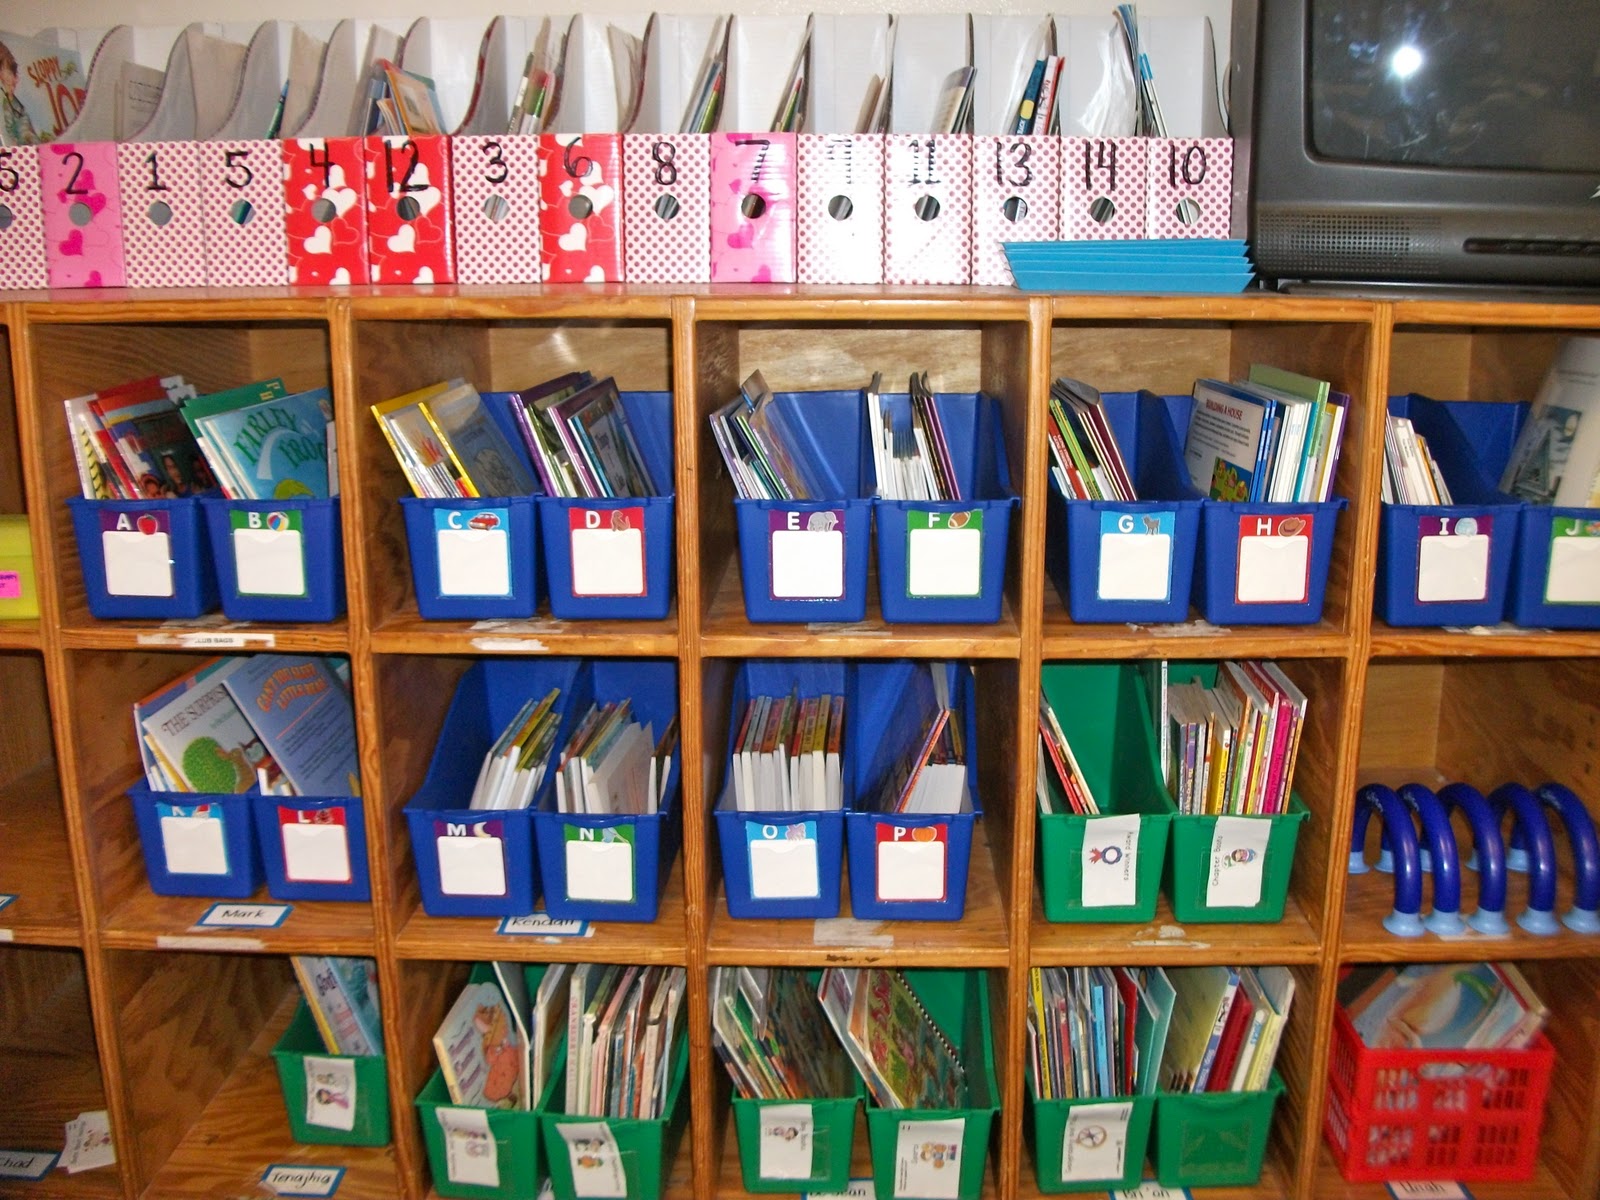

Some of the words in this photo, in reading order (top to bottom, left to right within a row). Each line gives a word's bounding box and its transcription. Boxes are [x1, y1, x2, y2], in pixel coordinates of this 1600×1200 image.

[310, 142, 334, 189] 4
[385, 140, 429, 193] 12
[484, 142, 508, 184] 3
[565, 137, 593, 178] 6
[653, 141, 677, 185] 8
[735, 139, 770, 183] 7
[996, 141, 1033, 187] 13
[1085, 141, 1117, 191] 14
[1170, 144, 1207, 189] 10
[62, 152, 88, 194] 2
[145, 152, 167, 190] 1
[225, 151, 253, 188] 5
[1206, 399, 1224, 414] BUILDING
[1228, 406, 1243, 420] HOUSE
[116, 513, 132, 531] A
[248, 512, 262, 529] B
[447, 511, 462, 530] C
[586, 510, 601, 529] D
[787, 512, 800, 530] E
[928, 512, 941, 529] F
[1118, 515, 1134, 533] G
[1256, 518, 1272, 536] H
[1439, 517, 1450, 536] I
[1565, 519, 1581, 537] J
[161, 711, 190, 736] THE
[297, 810, 310, 824] L
[447, 823, 467, 837] M
[580, 828, 595, 841] N
[761, 826, 778, 840] O
[894, 827, 907, 841] P
[1212, 857, 1221, 886] Chapter
[222, 909, 264, 918] Mark
